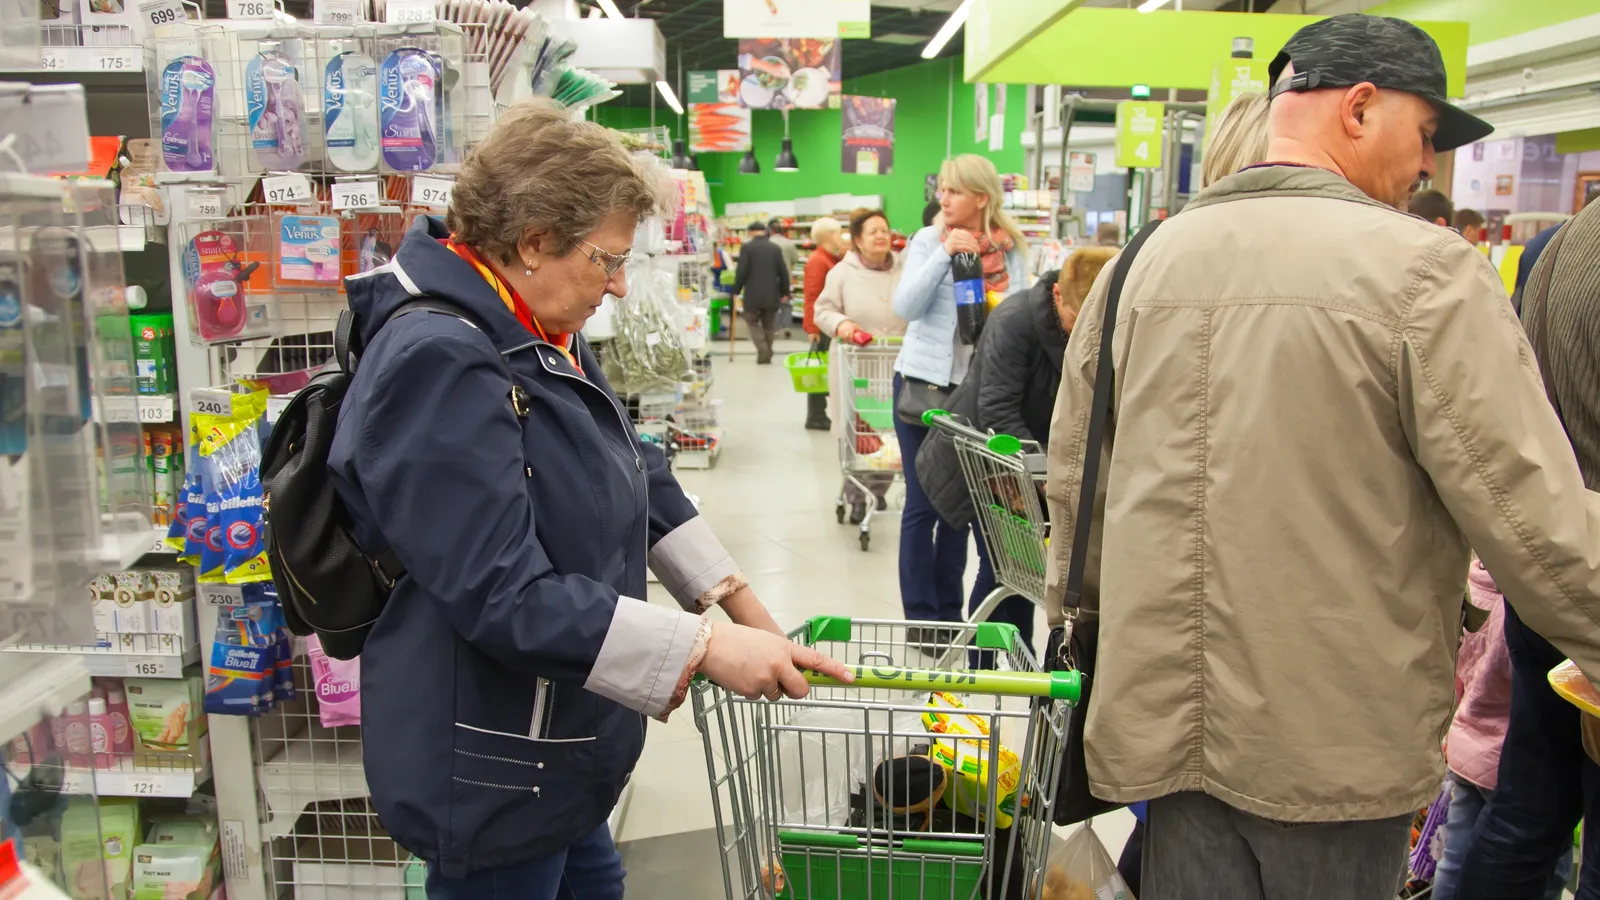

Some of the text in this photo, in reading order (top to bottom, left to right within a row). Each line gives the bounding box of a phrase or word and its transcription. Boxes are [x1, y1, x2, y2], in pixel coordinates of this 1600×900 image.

[238, 2, 264, 16] 786
[397, 9, 422, 22] 828
[150, 8, 175, 25] 699
[331, 12, 348, 21] 799
[99, 57, 123, 69] 175
[249, 71, 263, 116] Venus
[1134, 141, 1149, 160] 4
[269, 186, 295, 201] 974
[342, 193, 368, 207] 786
[422, 188, 447, 203] 974
[199, 205, 216, 215] 759
[283, 225, 320, 240] Venus
[140, 408, 163, 420] 103
[197, 401, 222, 414] 240
[220, 495, 263, 511] Gillette
[209, 593, 232, 605] 230
[228, 649, 260, 659] Gillette
[135, 664, 157, 675] 165
[133, 782, 154, 794] 121
